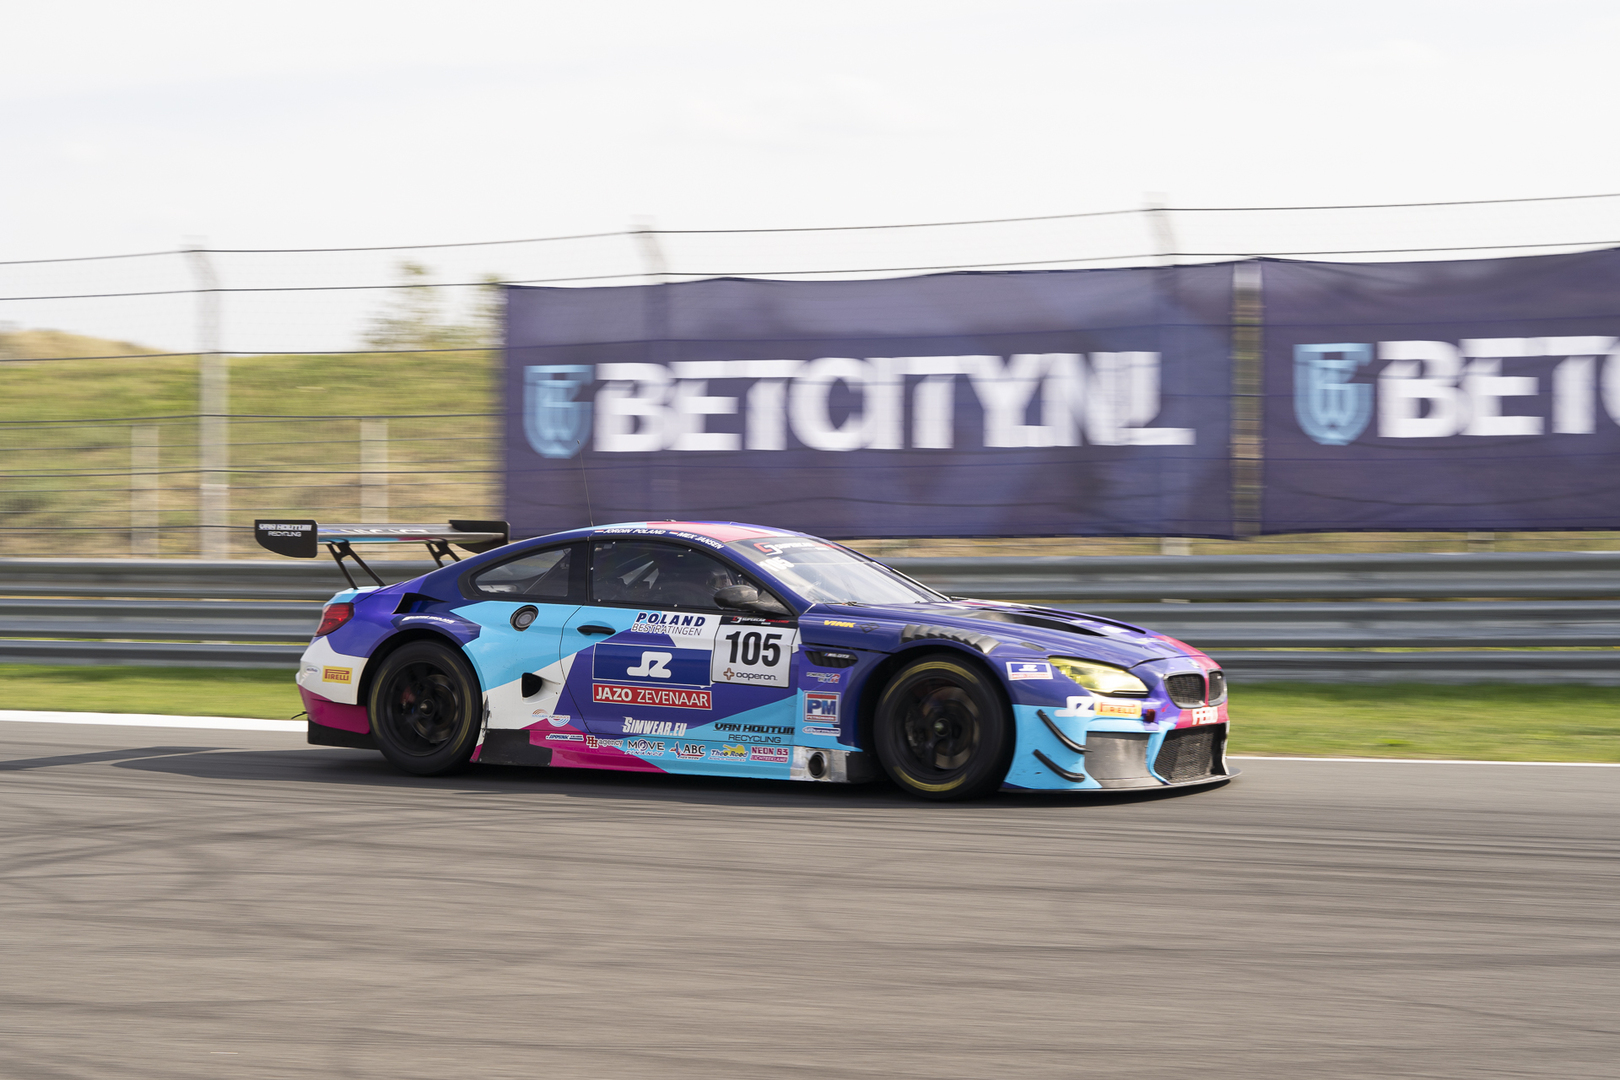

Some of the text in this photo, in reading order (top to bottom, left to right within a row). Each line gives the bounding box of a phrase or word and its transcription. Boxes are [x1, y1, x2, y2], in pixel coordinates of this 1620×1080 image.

[1377, 336, 1620, 438] BET
[267, 530, 302, 538] RECYCLING
[636, 612, 706, 627] POLAND
[824, 620, 856, 628] VINK
[631, 623, 702, 636] BESTRATINGEN
[725, 631, 783, 667] 105
[324, 668, 350, 681] PIRELLI
[596, 687, 709, 707] JAZO ZEVENAAR
[807, 699, 837, 715] PM
[1100, 701, 1136, 714] PIRELLI
[622, 716, 688, 737] SIMWEAR.EU
[714, 722, 743, 732] VAN
[743, 725, 795, 736] HOUTUM
[598, 739, 623, 747] agency
[728, 734, 781, 744] RECYCLING
[683, 744, 705, 755] ABC
[711, 749, 728, 757] Theo
[751, 746, 774, 755] NEON
